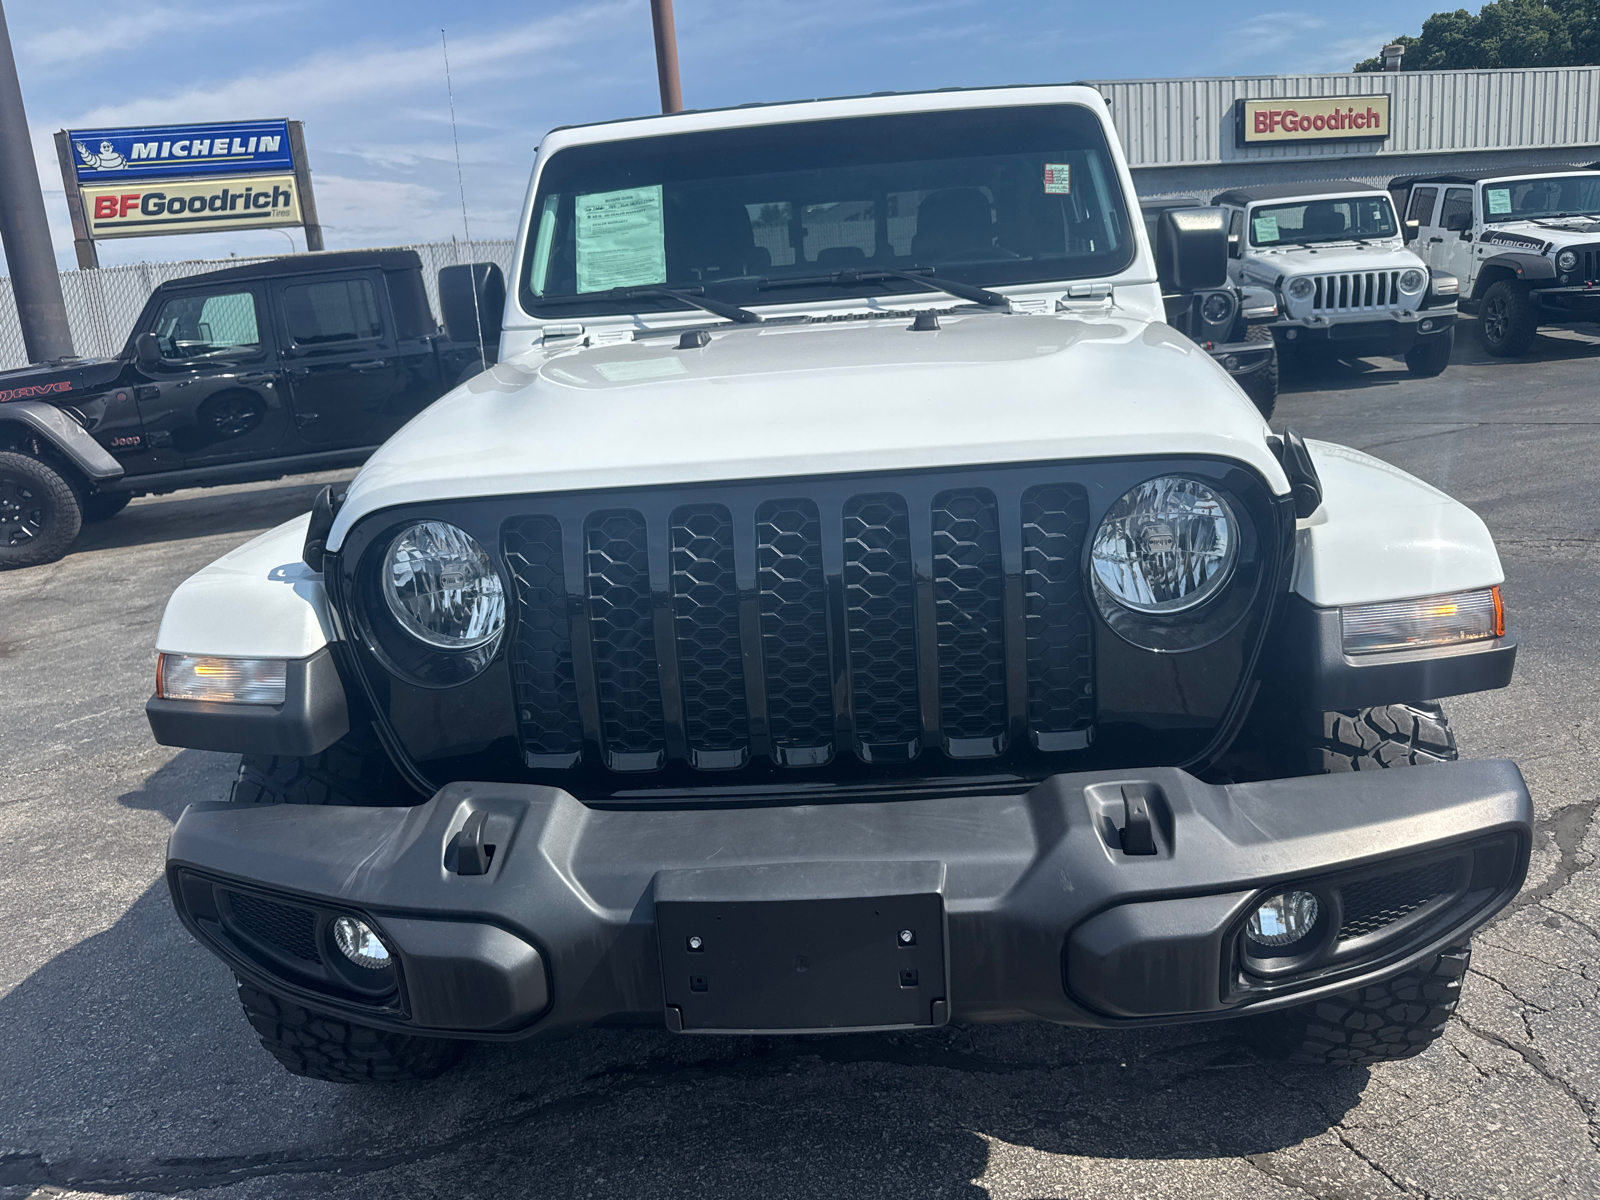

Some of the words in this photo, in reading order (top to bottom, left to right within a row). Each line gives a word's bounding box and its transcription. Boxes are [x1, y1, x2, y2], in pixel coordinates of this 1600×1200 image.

[1254, 105, 1380, 133] BFGoodrich
[131, 135, 281, 159] MICHELIN
[94, 185, 291, 219] BFGoodrich
[271, 209, 290, 218] Tires
[1491, 238, 1541, 250] RUBICON
[0, 381, 73, 402] JAVE
[111, 436, 141, 447] Jeep
